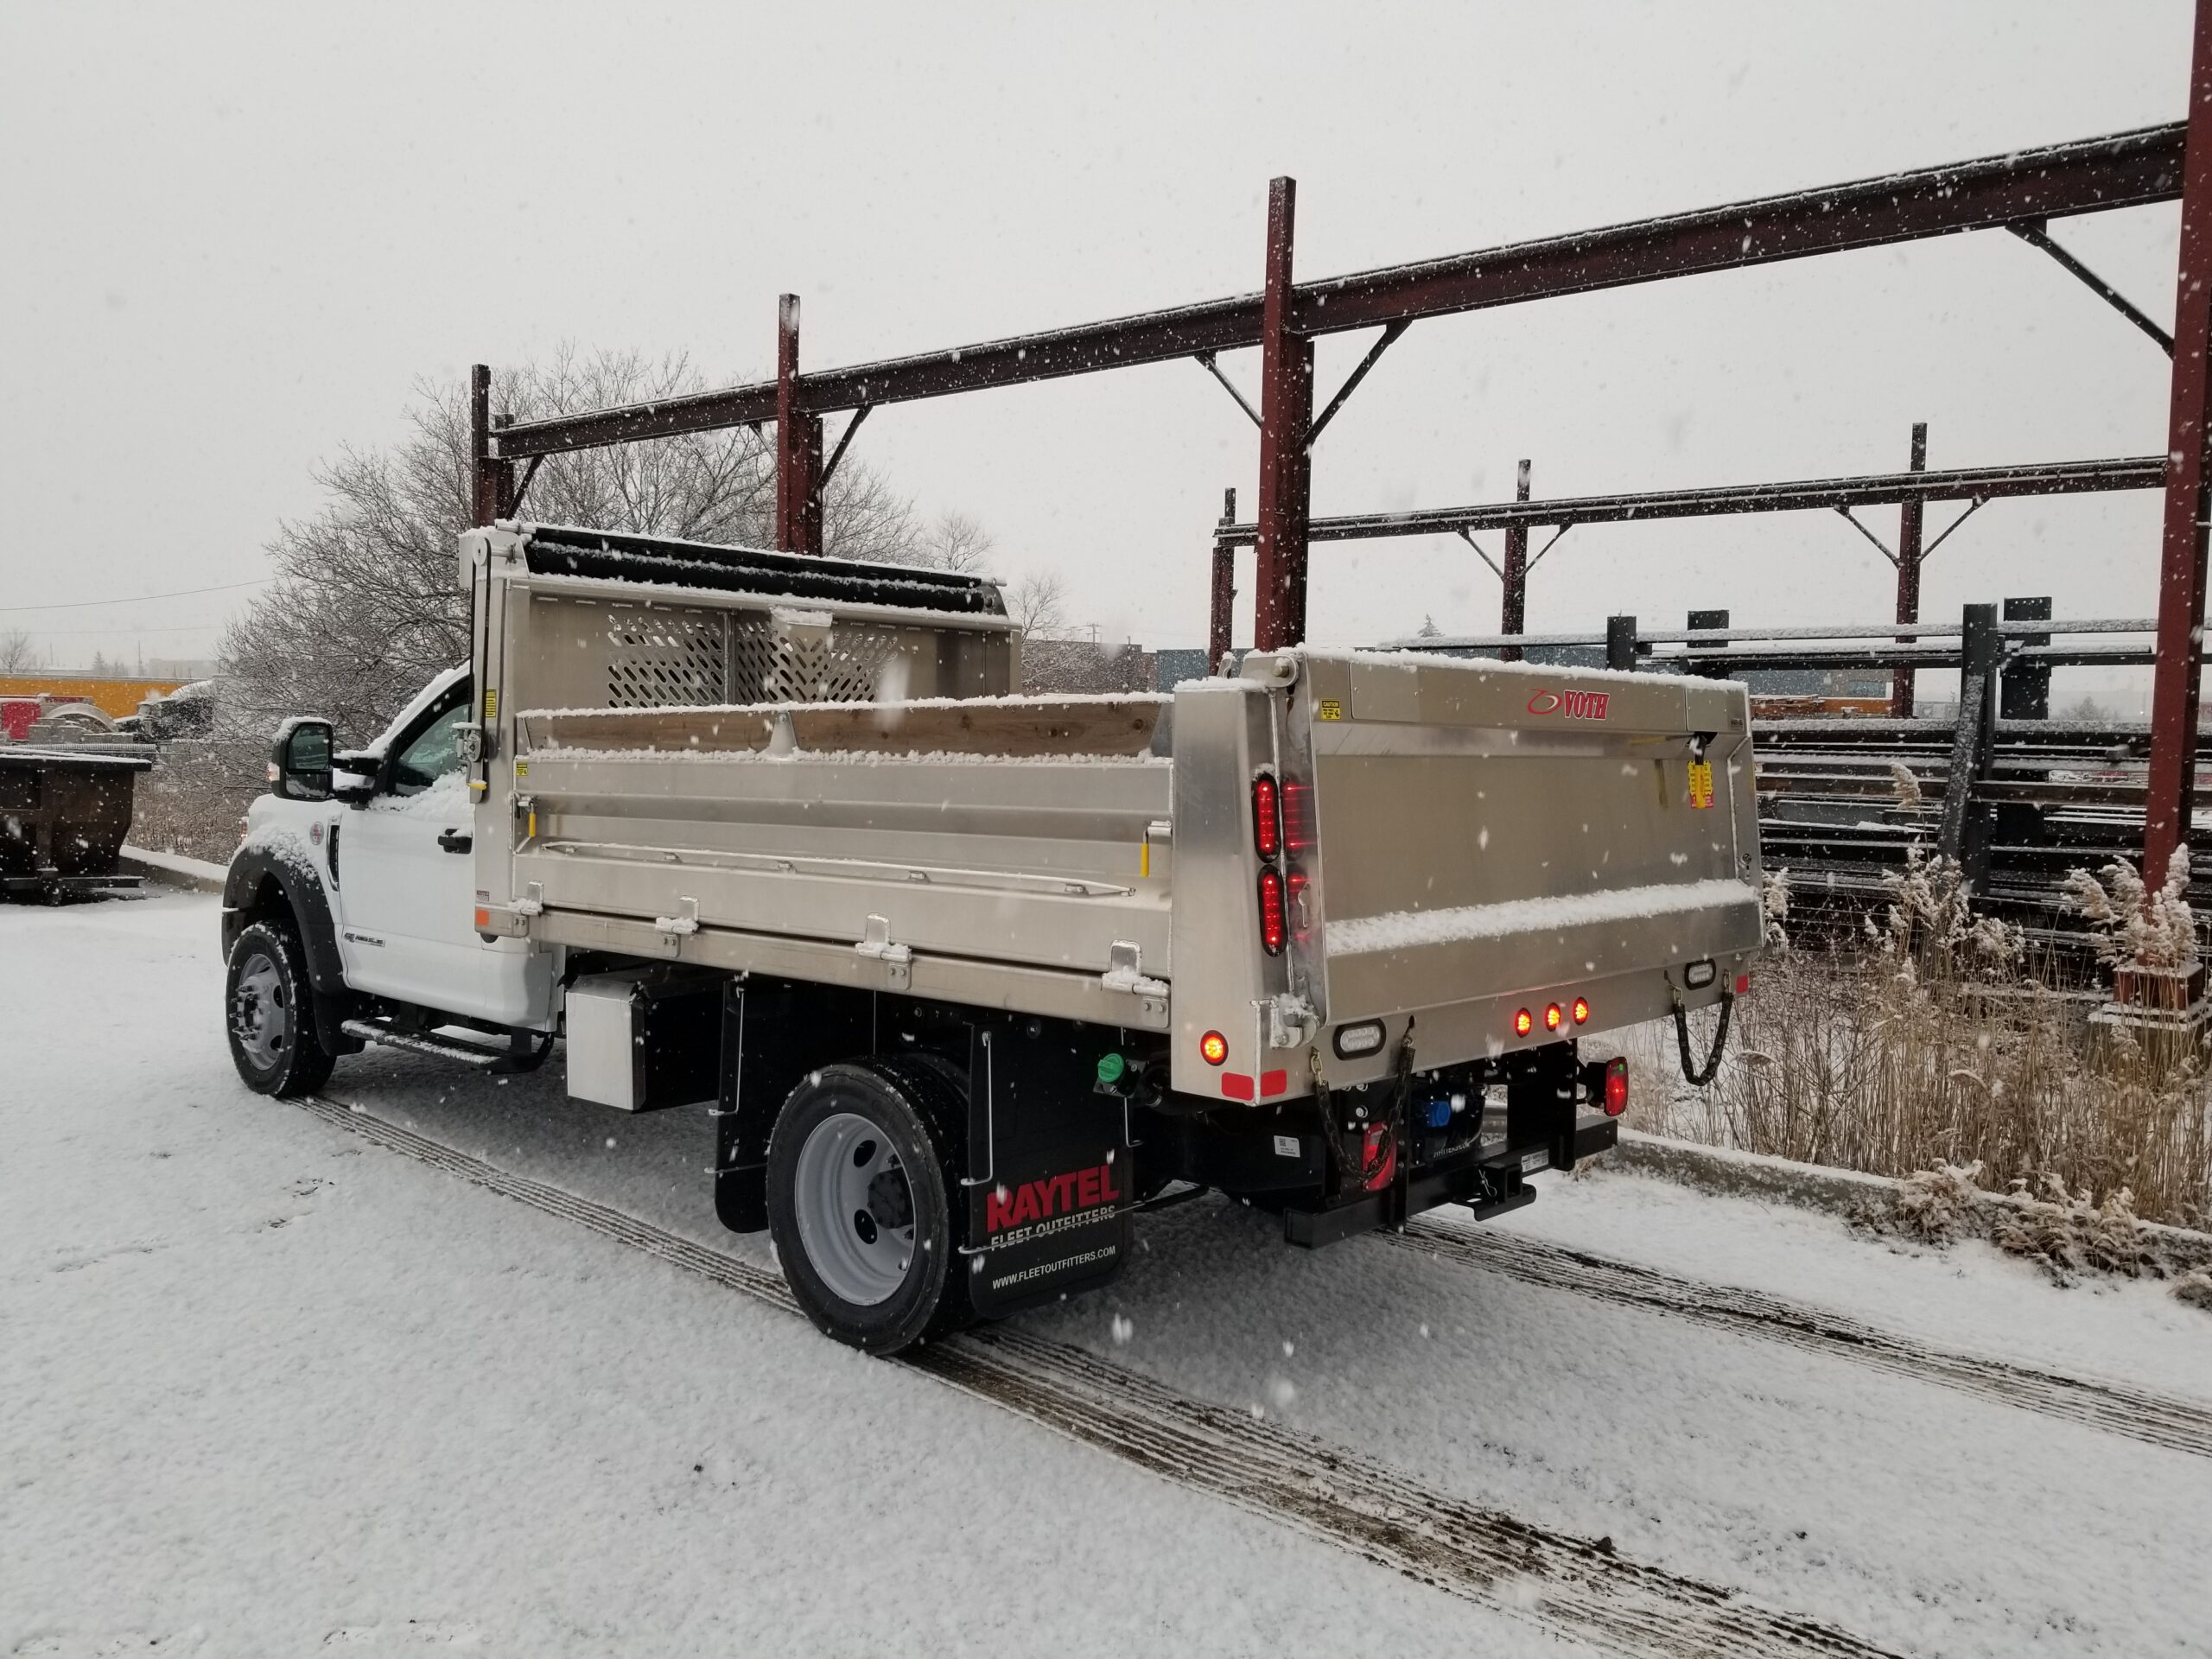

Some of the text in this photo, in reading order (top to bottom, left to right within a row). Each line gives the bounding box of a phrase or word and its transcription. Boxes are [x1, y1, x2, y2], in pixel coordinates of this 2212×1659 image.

[1564, 690, 1610, 721] VOTH
[987, 1165, 1119, 1232] RAYTEL
[990, 1205, 1115, 1251] FLEET OUTFITTERS
[993, 1245, 1116, 1289] WWW.FLEETOUTFITTERS.COM
